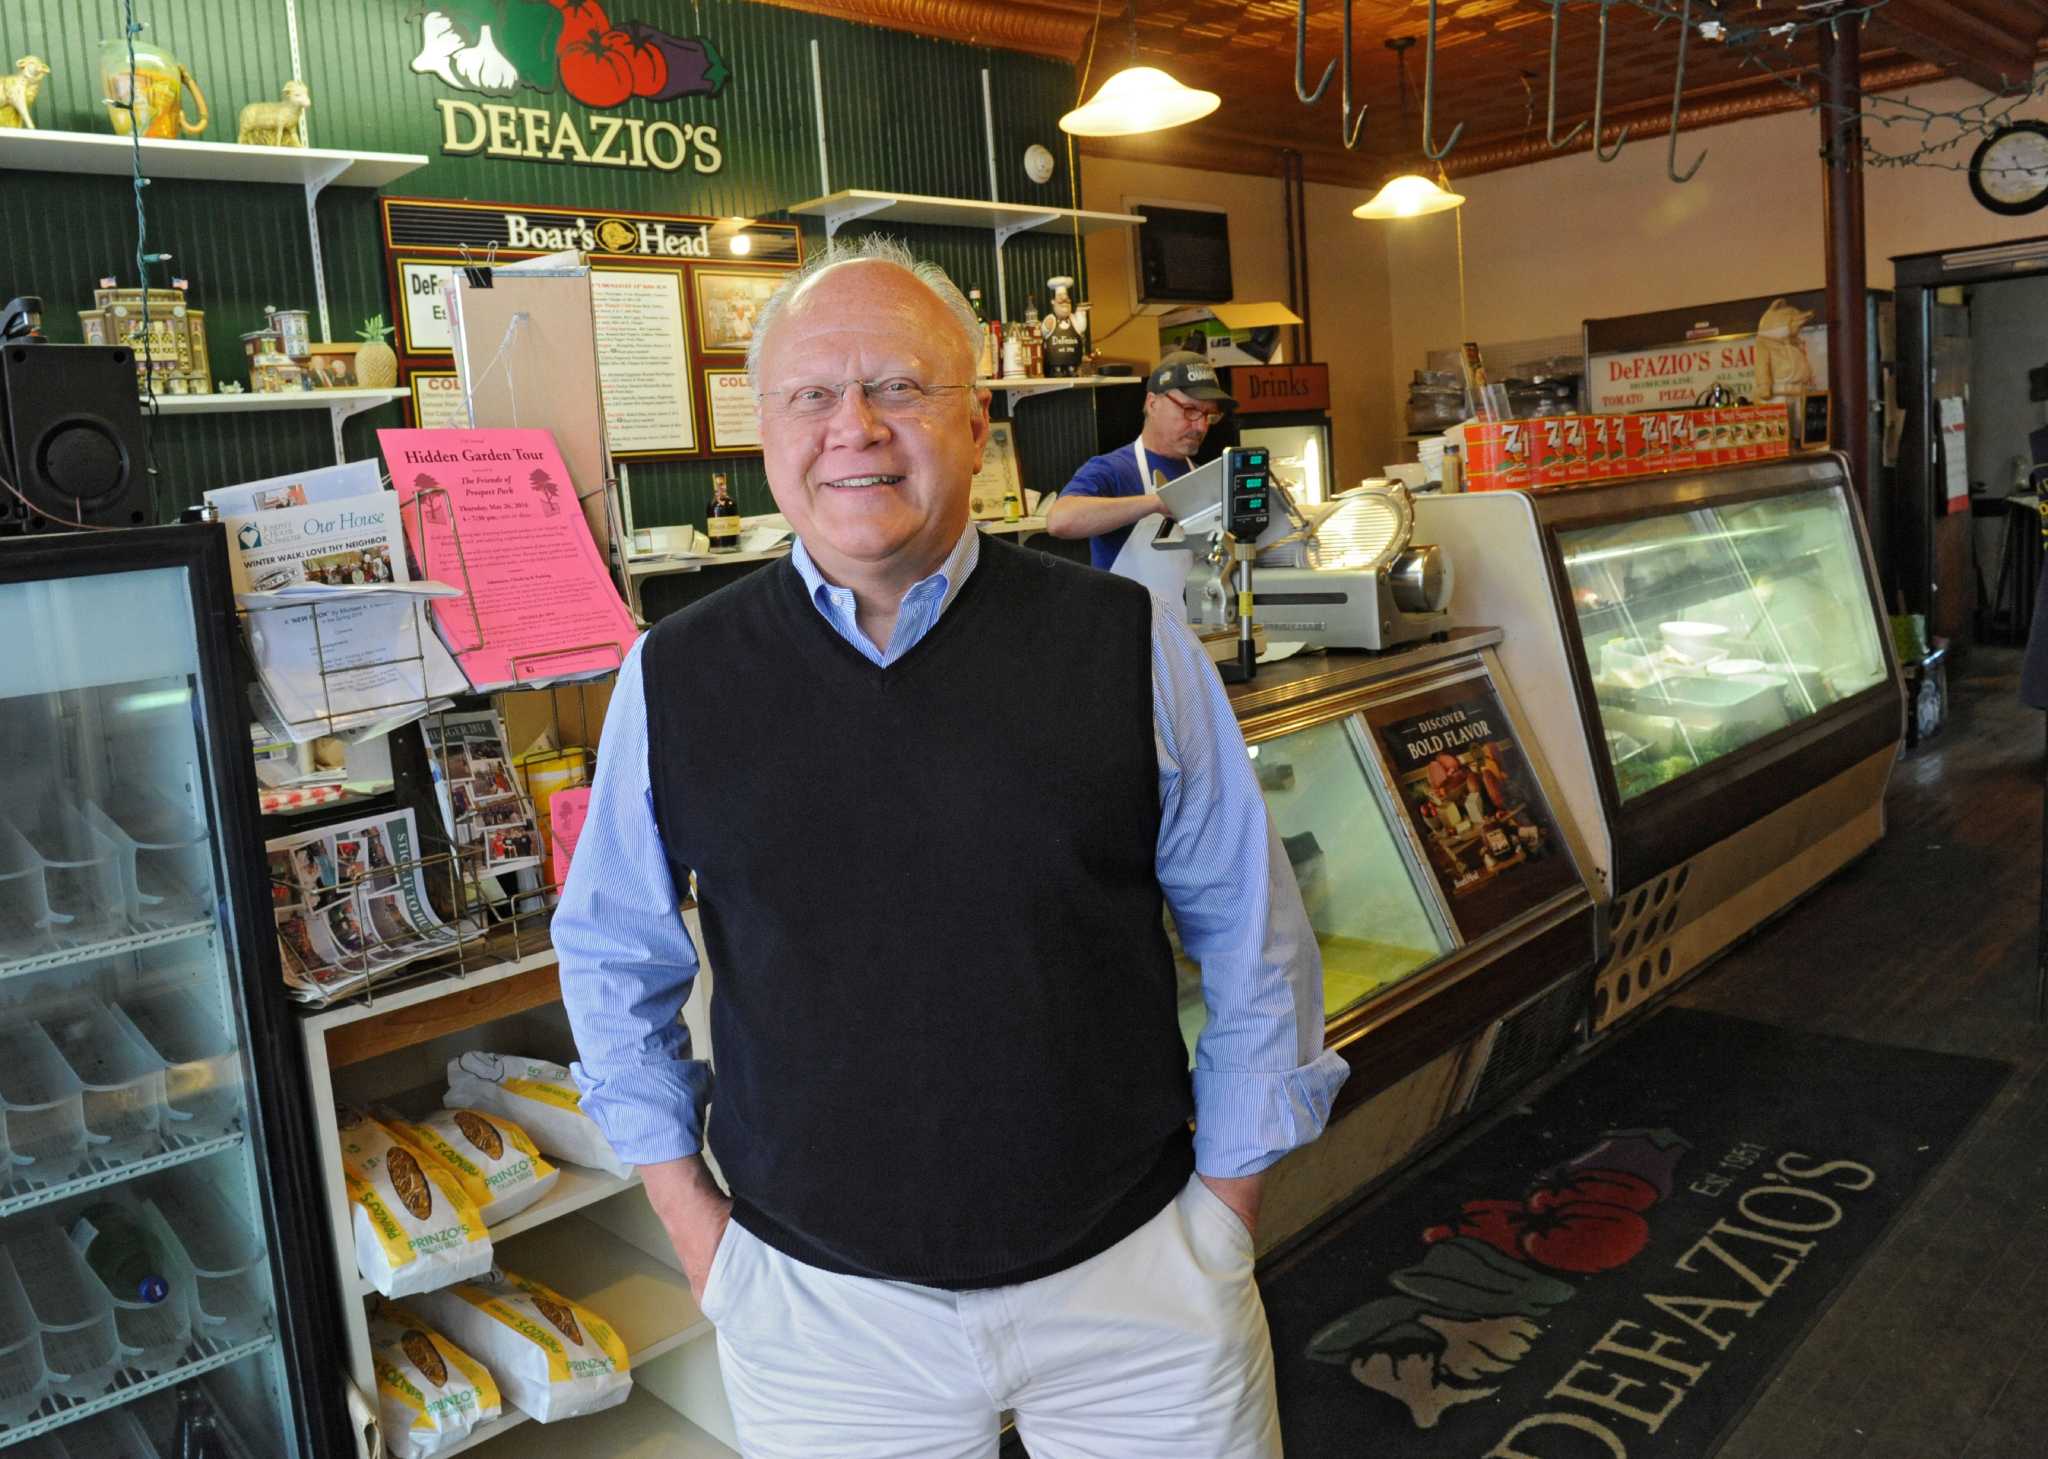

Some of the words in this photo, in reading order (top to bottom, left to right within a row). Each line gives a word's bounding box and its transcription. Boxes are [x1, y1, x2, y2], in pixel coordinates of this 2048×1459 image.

[436, 98, 723, 174] DEFAZIO'S
[504, 214, 596, 251] Boar's
[635, 223, 711, 256] Head
[1609, 351, 1711, 382] DeFAZIO'S
[1249, 367, 1310, 399] Drinks
[1658, 388, 1697, 402] PIZZA
[405, 450, 458, 464] Hidden
[462, 449, 511, 461] Garden
[512, 448, 544, 460] Tour
[497, 487, 514, 495] Park
[304, 518, 336, 537] Our
[340, 511, 385, 530] House
[243, 556, 276, 569] WINTER
[306, 546, 329, 558] LOVE
[328, 543, 344, 553] THY
[345, 535, 388, 549] NEIGHBOR
[428, 725, 467, 741] HUGER
[1418, 710, 1467, 734] DISCOVER
[1407, 735, 1444, 760] BOLD
[1442, 720, 1492, 748] FLAVOR
[397, 832, 410, 874] STIC
[486, 1155, 538, 1189] PRINZO'S
[408, 1223, 470, 1250] PRINZO'S
